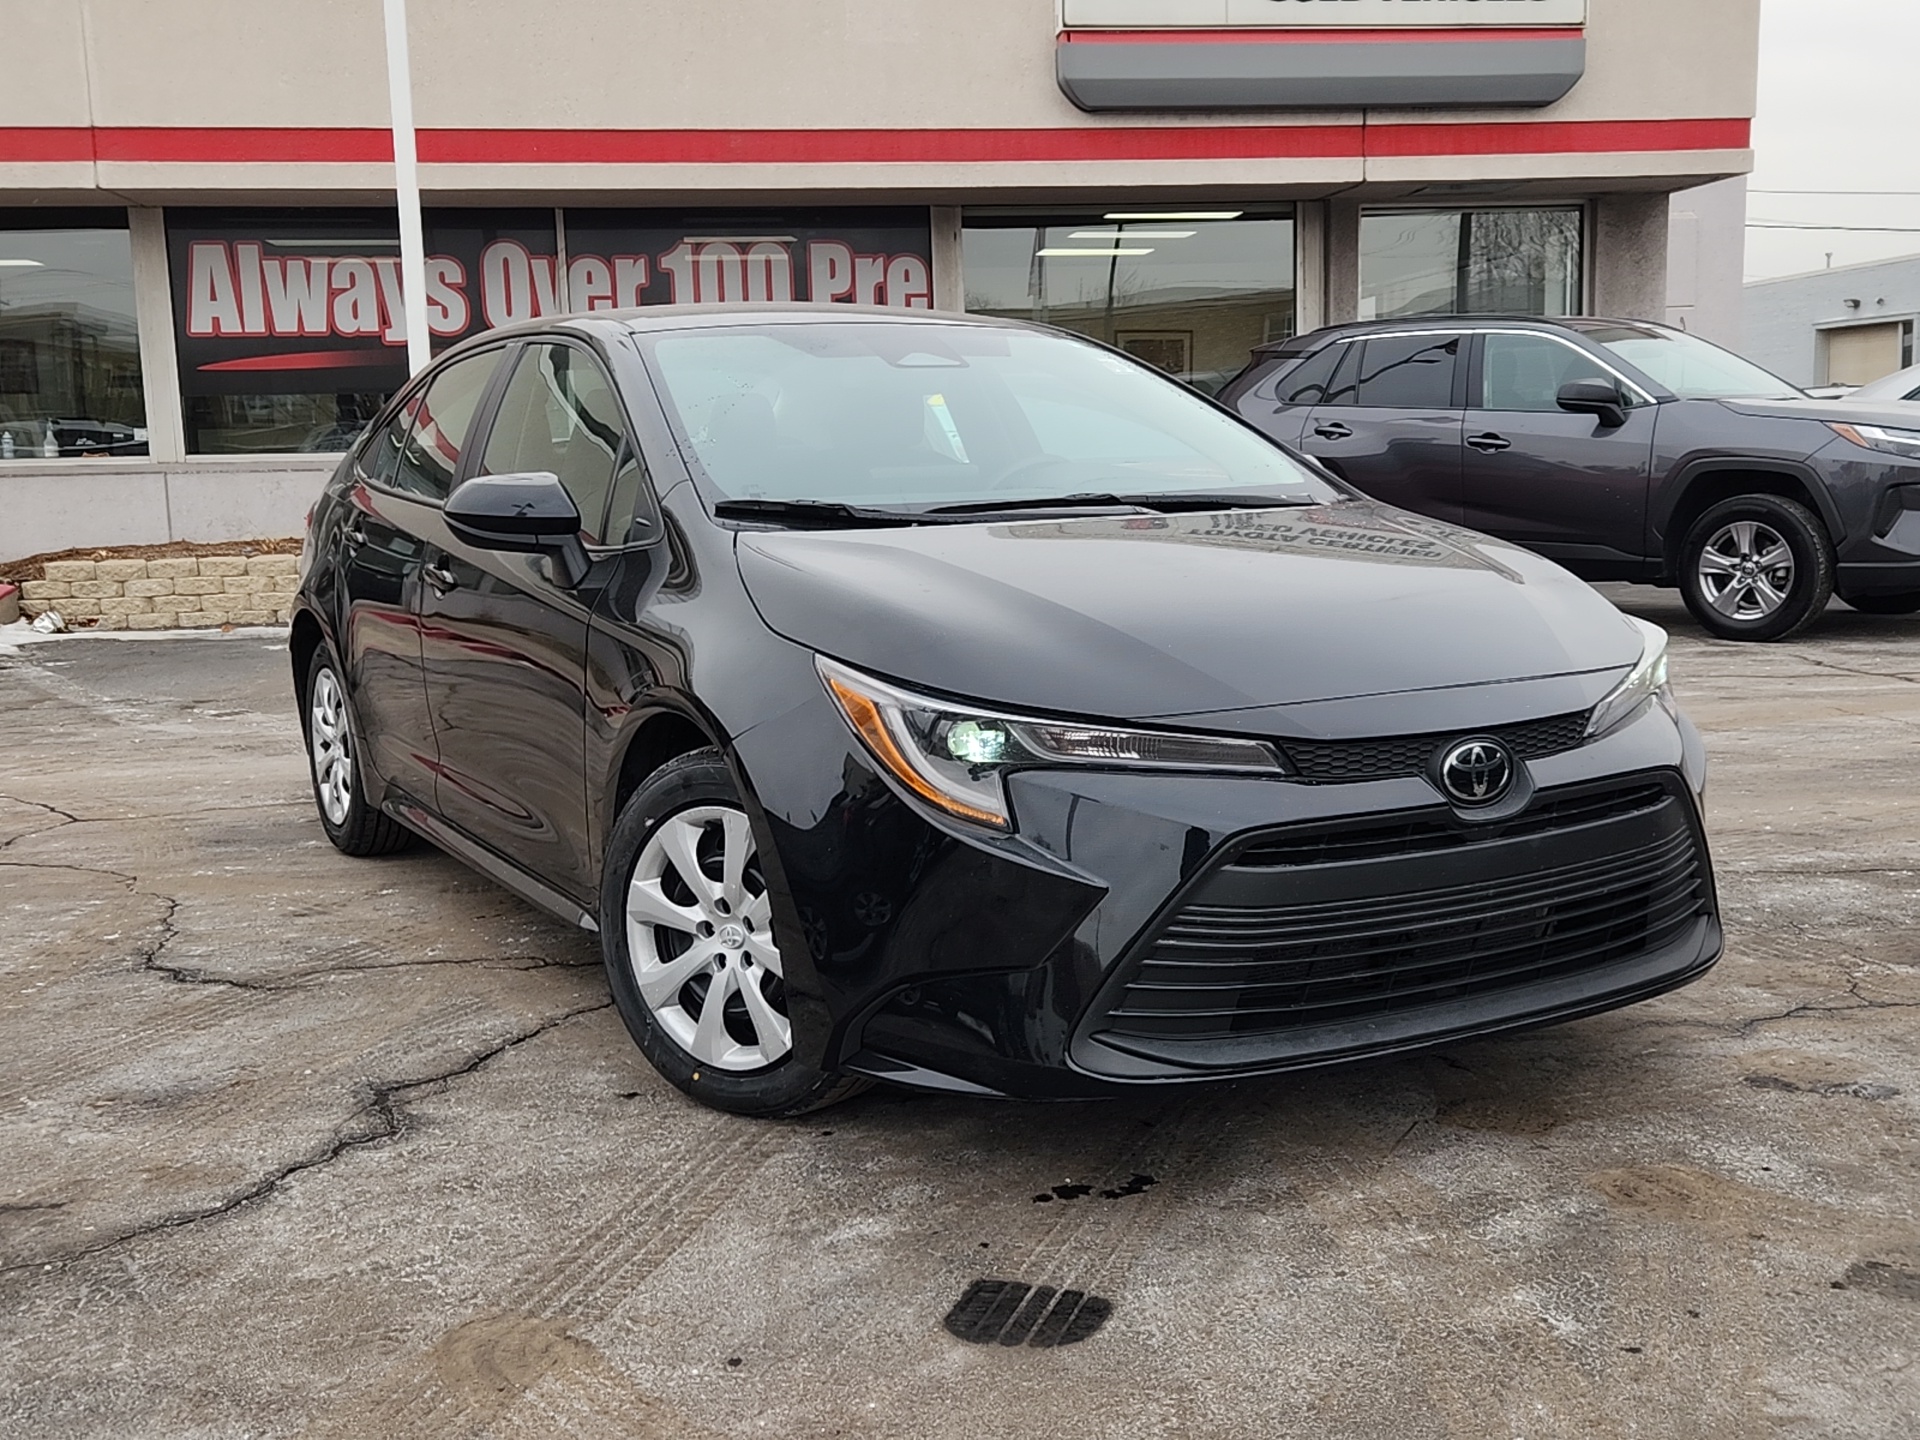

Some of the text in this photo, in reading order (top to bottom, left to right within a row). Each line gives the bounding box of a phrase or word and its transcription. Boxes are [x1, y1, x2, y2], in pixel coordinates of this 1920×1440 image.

[186, 239, 931, 345] Always Over 100 Pre
